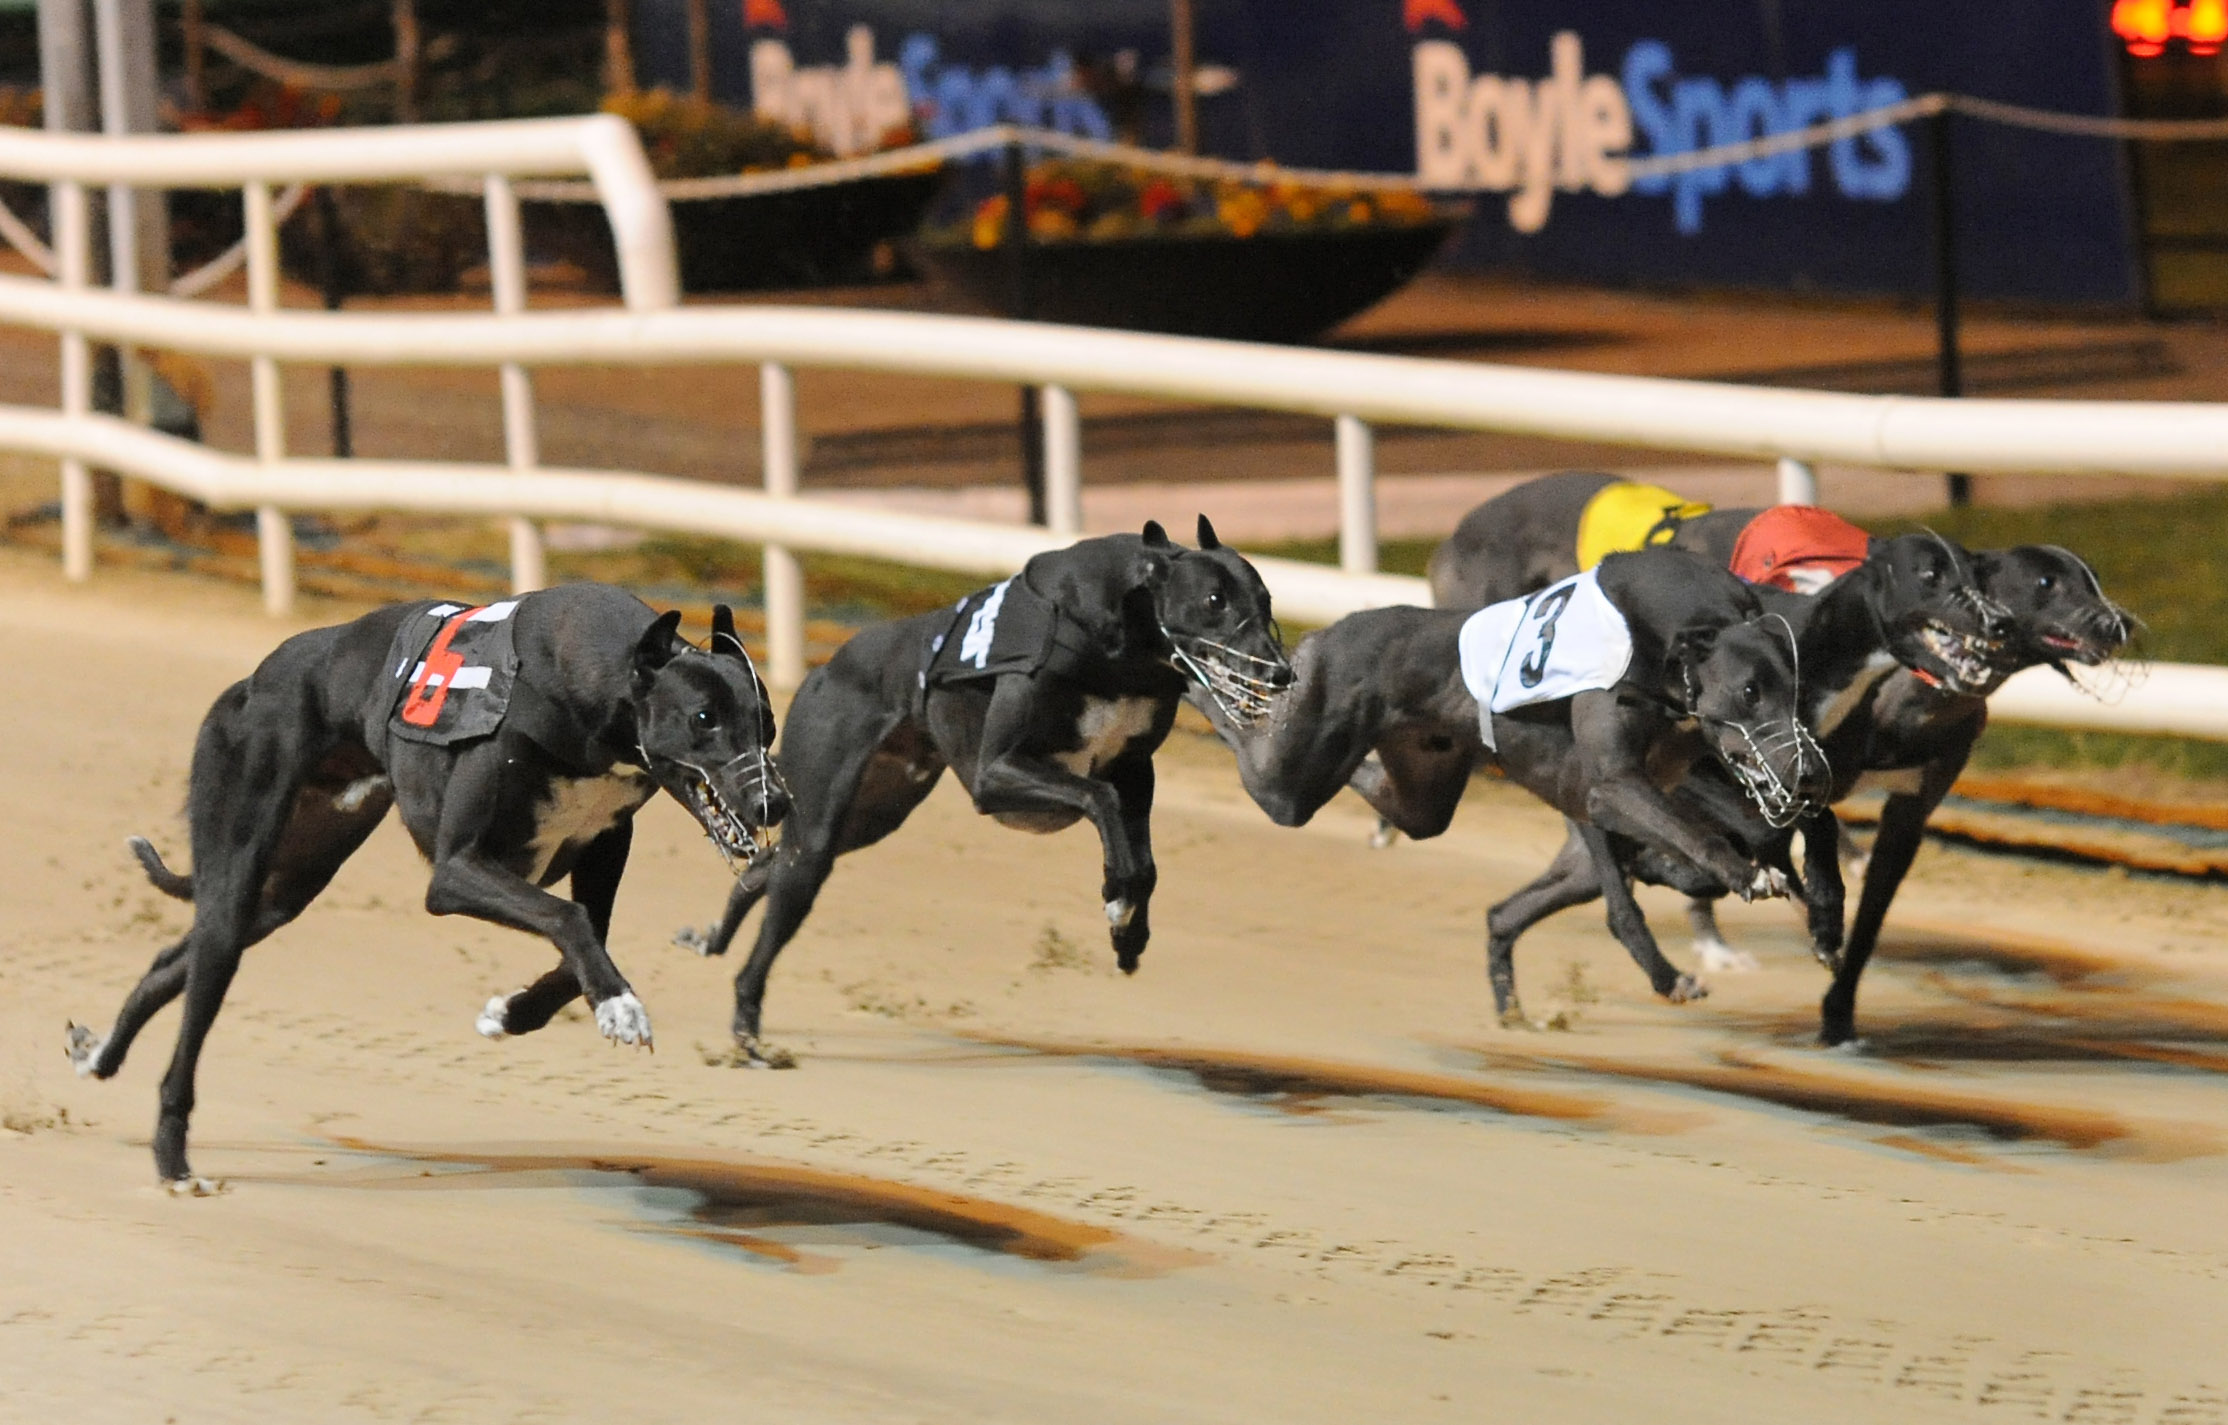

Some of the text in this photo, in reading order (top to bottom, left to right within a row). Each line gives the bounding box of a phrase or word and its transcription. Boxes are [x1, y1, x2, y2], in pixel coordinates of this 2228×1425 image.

[1411, 31, 1911, 234] BoyleSports
[402, 606, 487, 727] 6
[1520, 582, 1577, 688] 3
